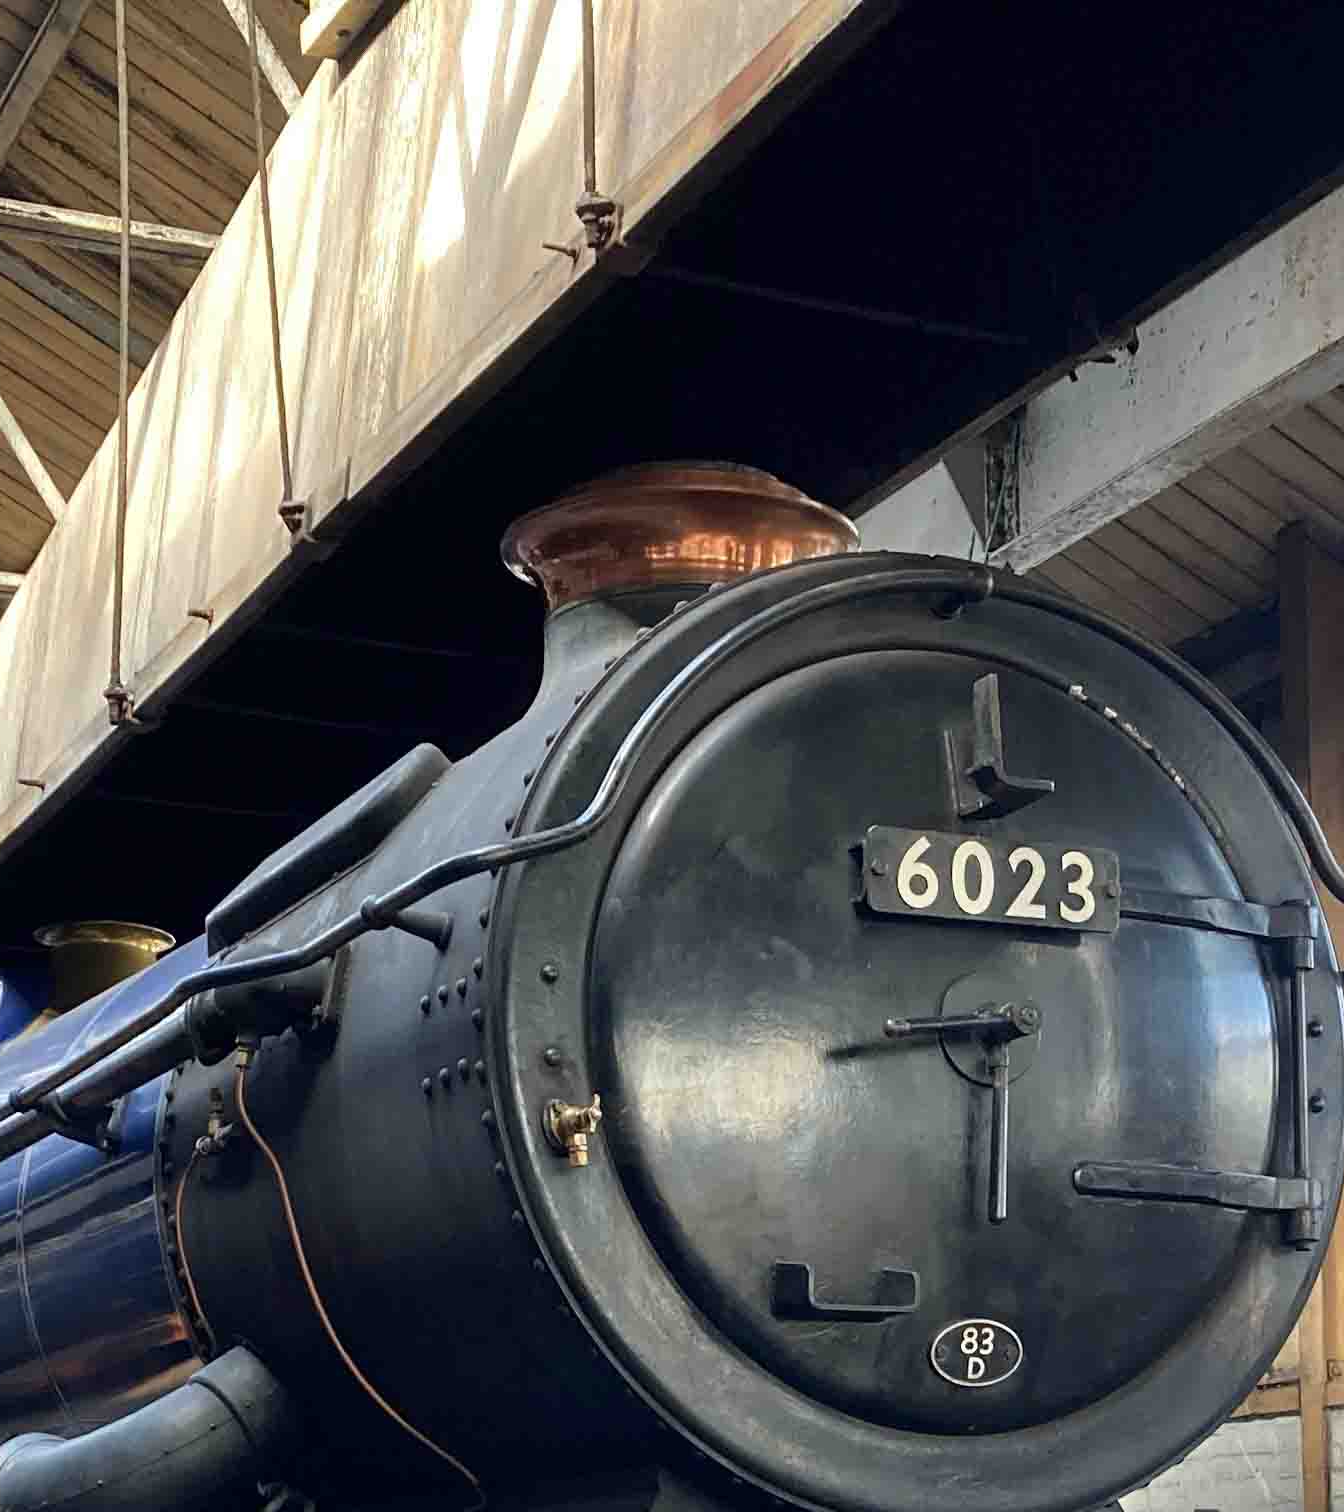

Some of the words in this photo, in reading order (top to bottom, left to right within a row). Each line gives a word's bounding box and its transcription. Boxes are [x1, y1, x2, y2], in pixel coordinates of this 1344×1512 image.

[897, 836, 1096, 923] 6023
[960, 1326, 995, 1355] 83
[967, 1356, 985, 1379] D
